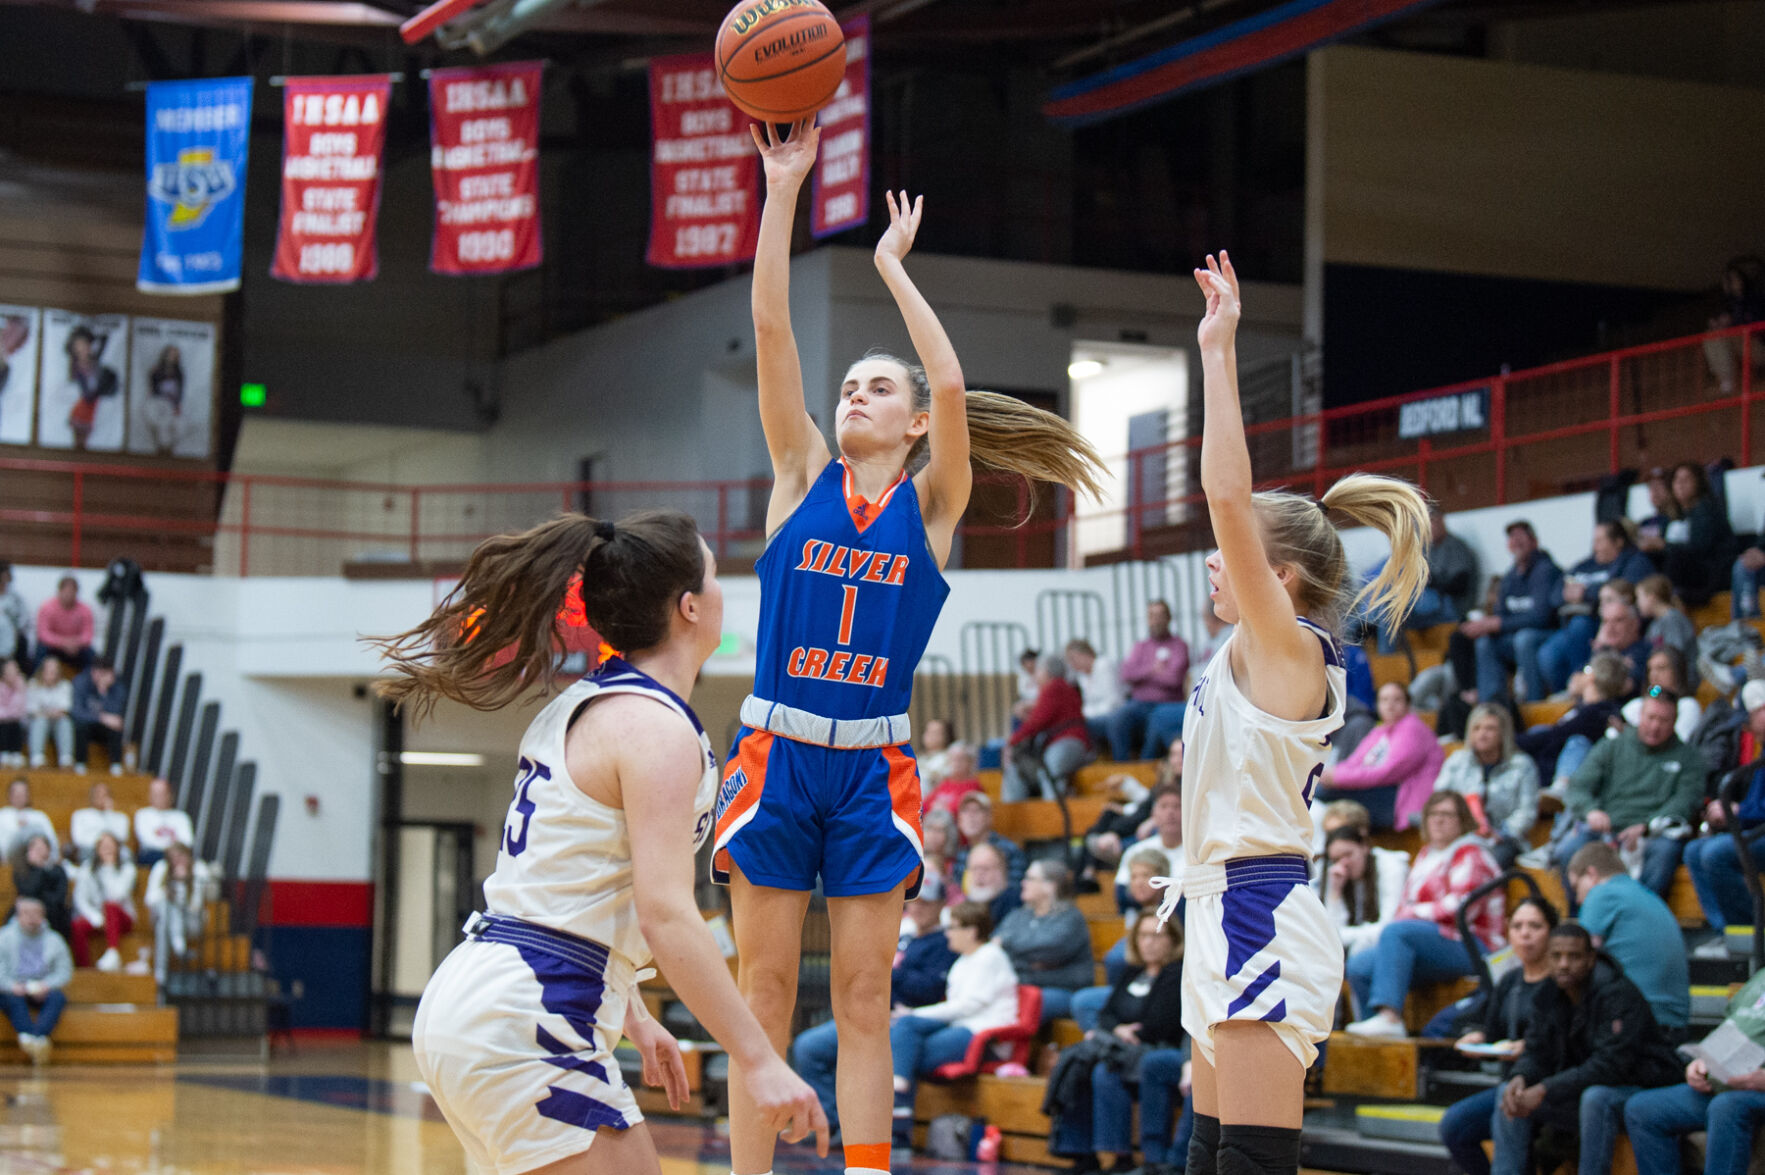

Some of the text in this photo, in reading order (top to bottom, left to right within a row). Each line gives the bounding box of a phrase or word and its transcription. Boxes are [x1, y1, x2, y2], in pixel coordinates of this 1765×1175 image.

[755, 24, 827, 62] EVOLUTION
[446, 78, 528, 113] IHSAA
[660, 68, 729, 103] IHSA
[292, 93, 380, 126] IHSAA
[302, 187, 358, 211] STATE
[794, 537, 910, 586] SILVER
[837, 584, 858, 646] 1
[786, 645, 890, 689] CREEK
